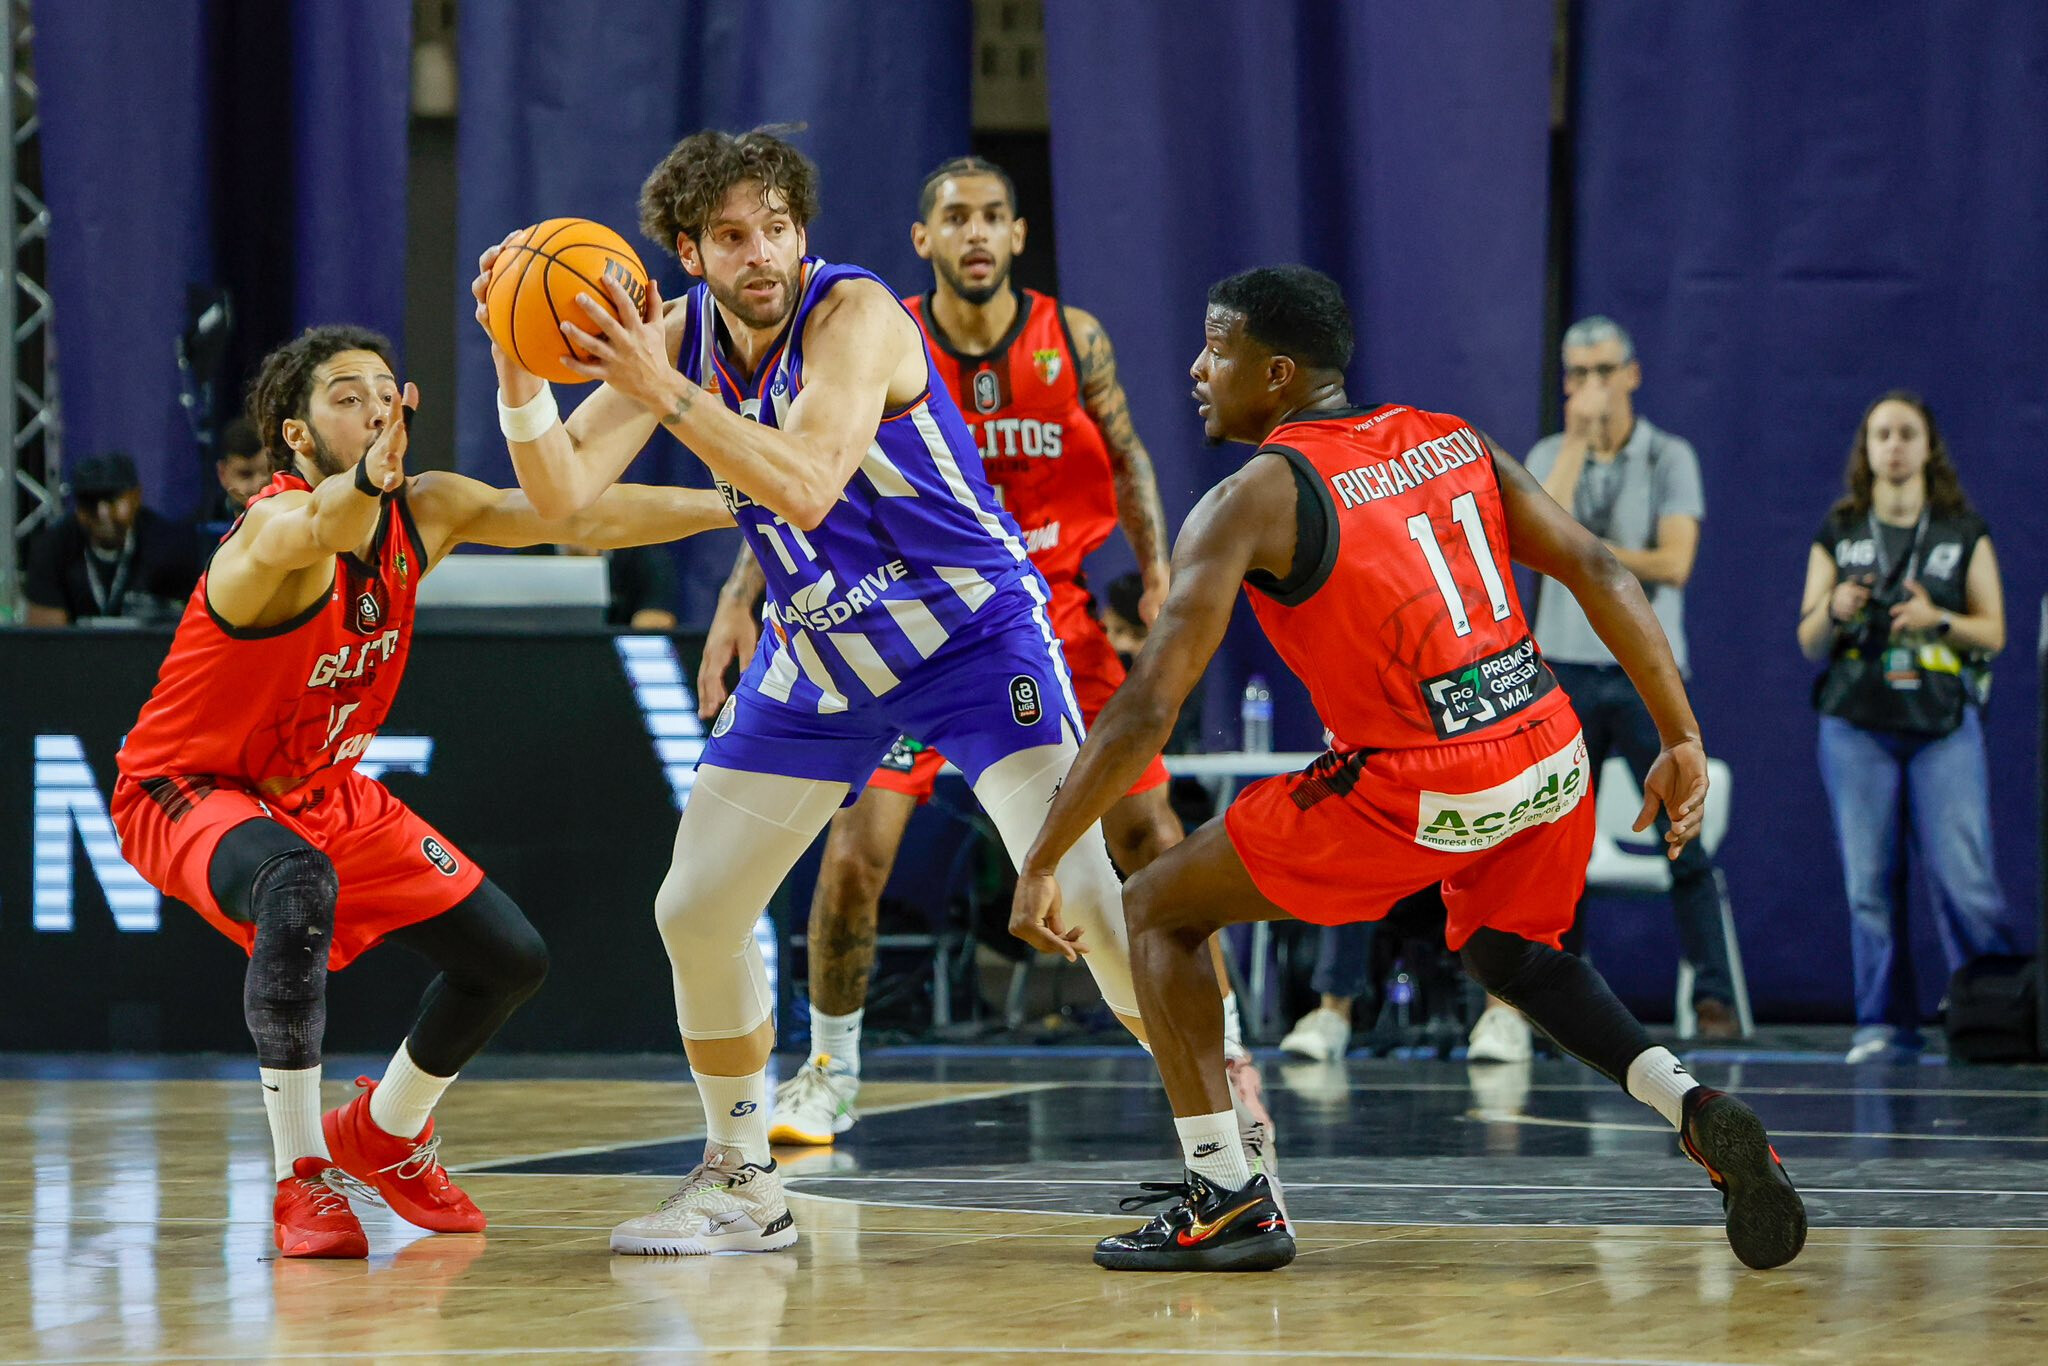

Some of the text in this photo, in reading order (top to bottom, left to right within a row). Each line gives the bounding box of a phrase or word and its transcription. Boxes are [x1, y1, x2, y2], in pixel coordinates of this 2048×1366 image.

[756, 513, 818, 576] 11
[1406, 491, 1512, 638] 11
[1450, 687, 1474, 704] PG
[1499, 684, 1534, 711] MAIL
[1423, 767, 1580, 836] Acede
[1470, 836, 1483, 846] de
[1196, 1142, 1220, 1152] NIKE
